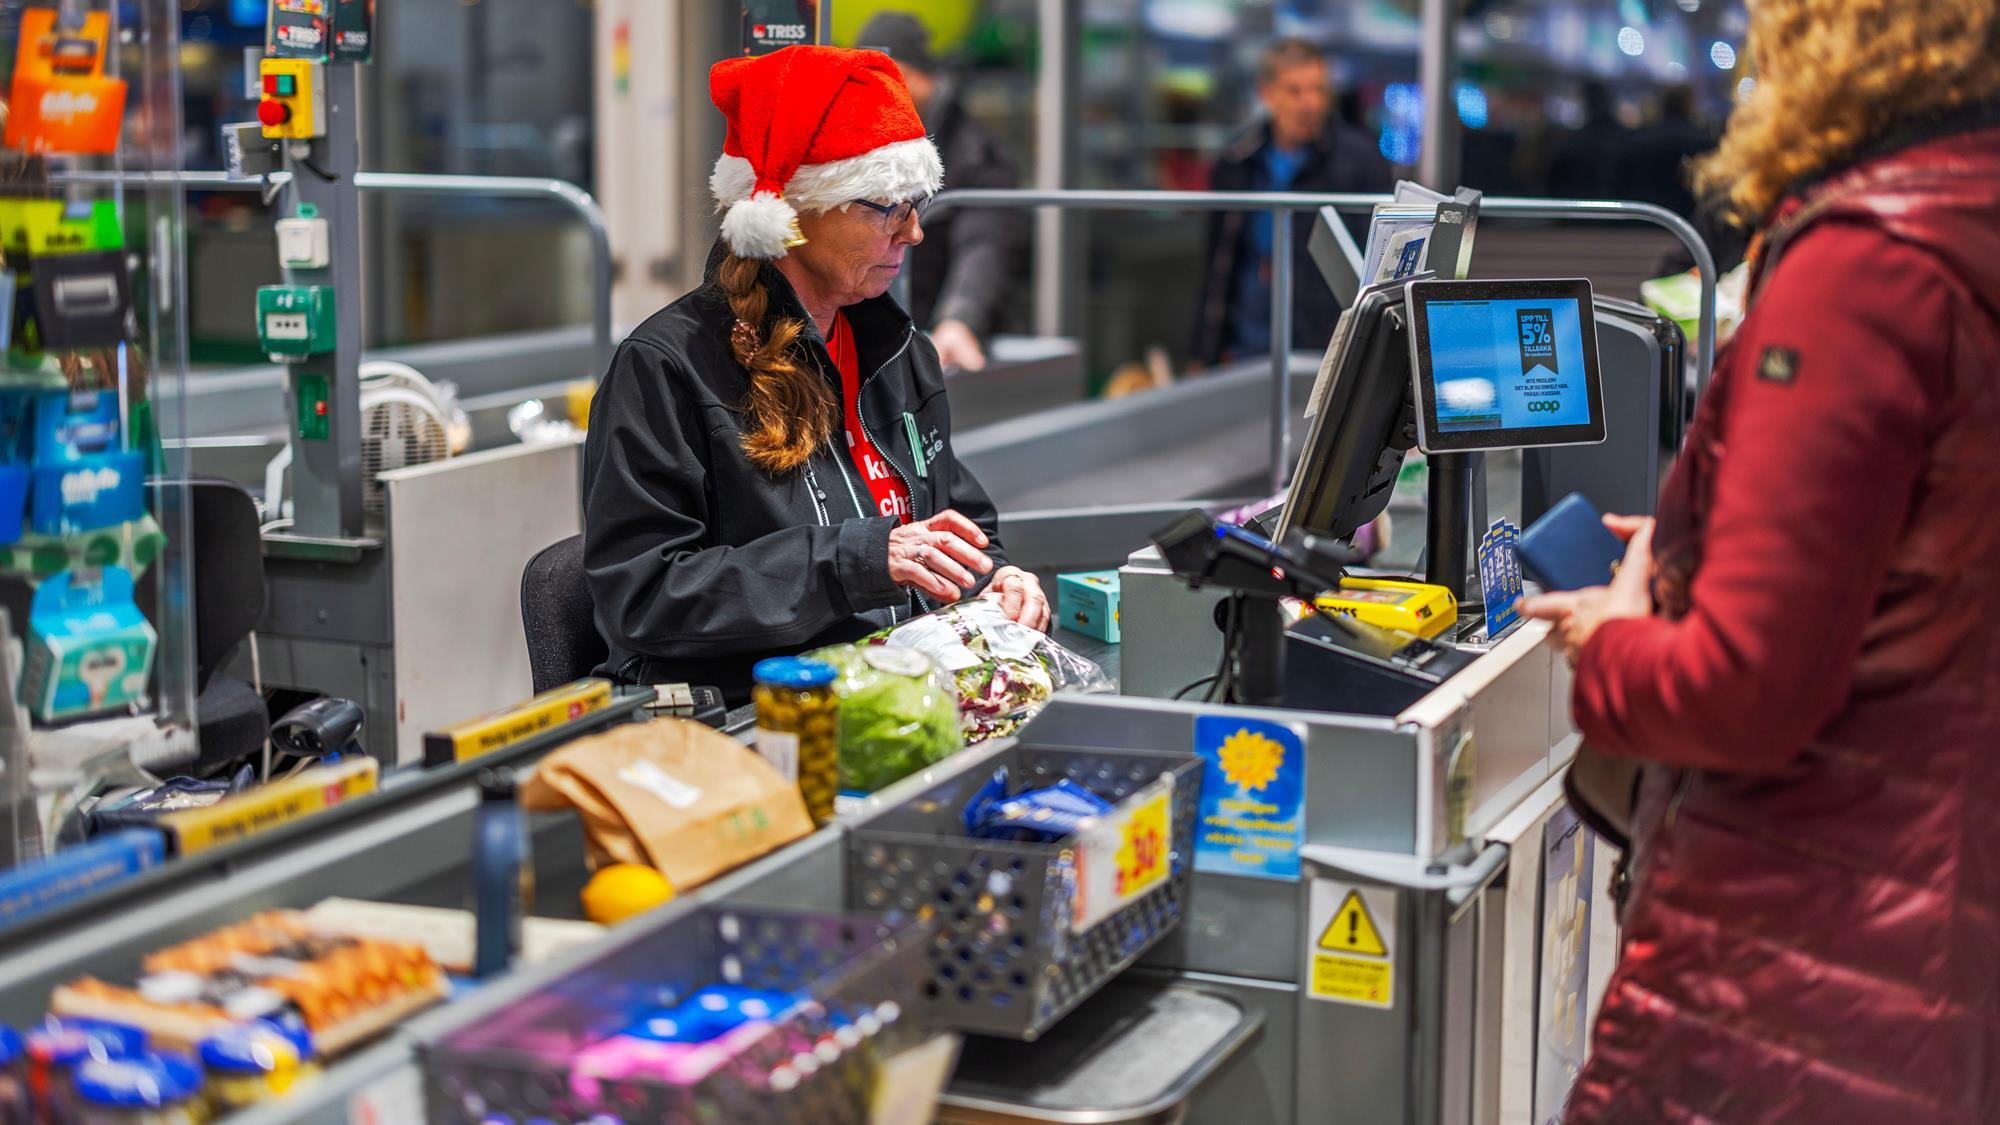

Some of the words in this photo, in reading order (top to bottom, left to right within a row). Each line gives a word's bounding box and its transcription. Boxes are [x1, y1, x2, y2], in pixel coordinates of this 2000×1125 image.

[766, 24, 806, 39] TRISS
[1520, 315, 1535, 323] UPP
[1522, 323, 1551, 345] 5%
[1523, 345, 1552, 353] TILLBAKA
[1528, 401, 1560, 413] coop
